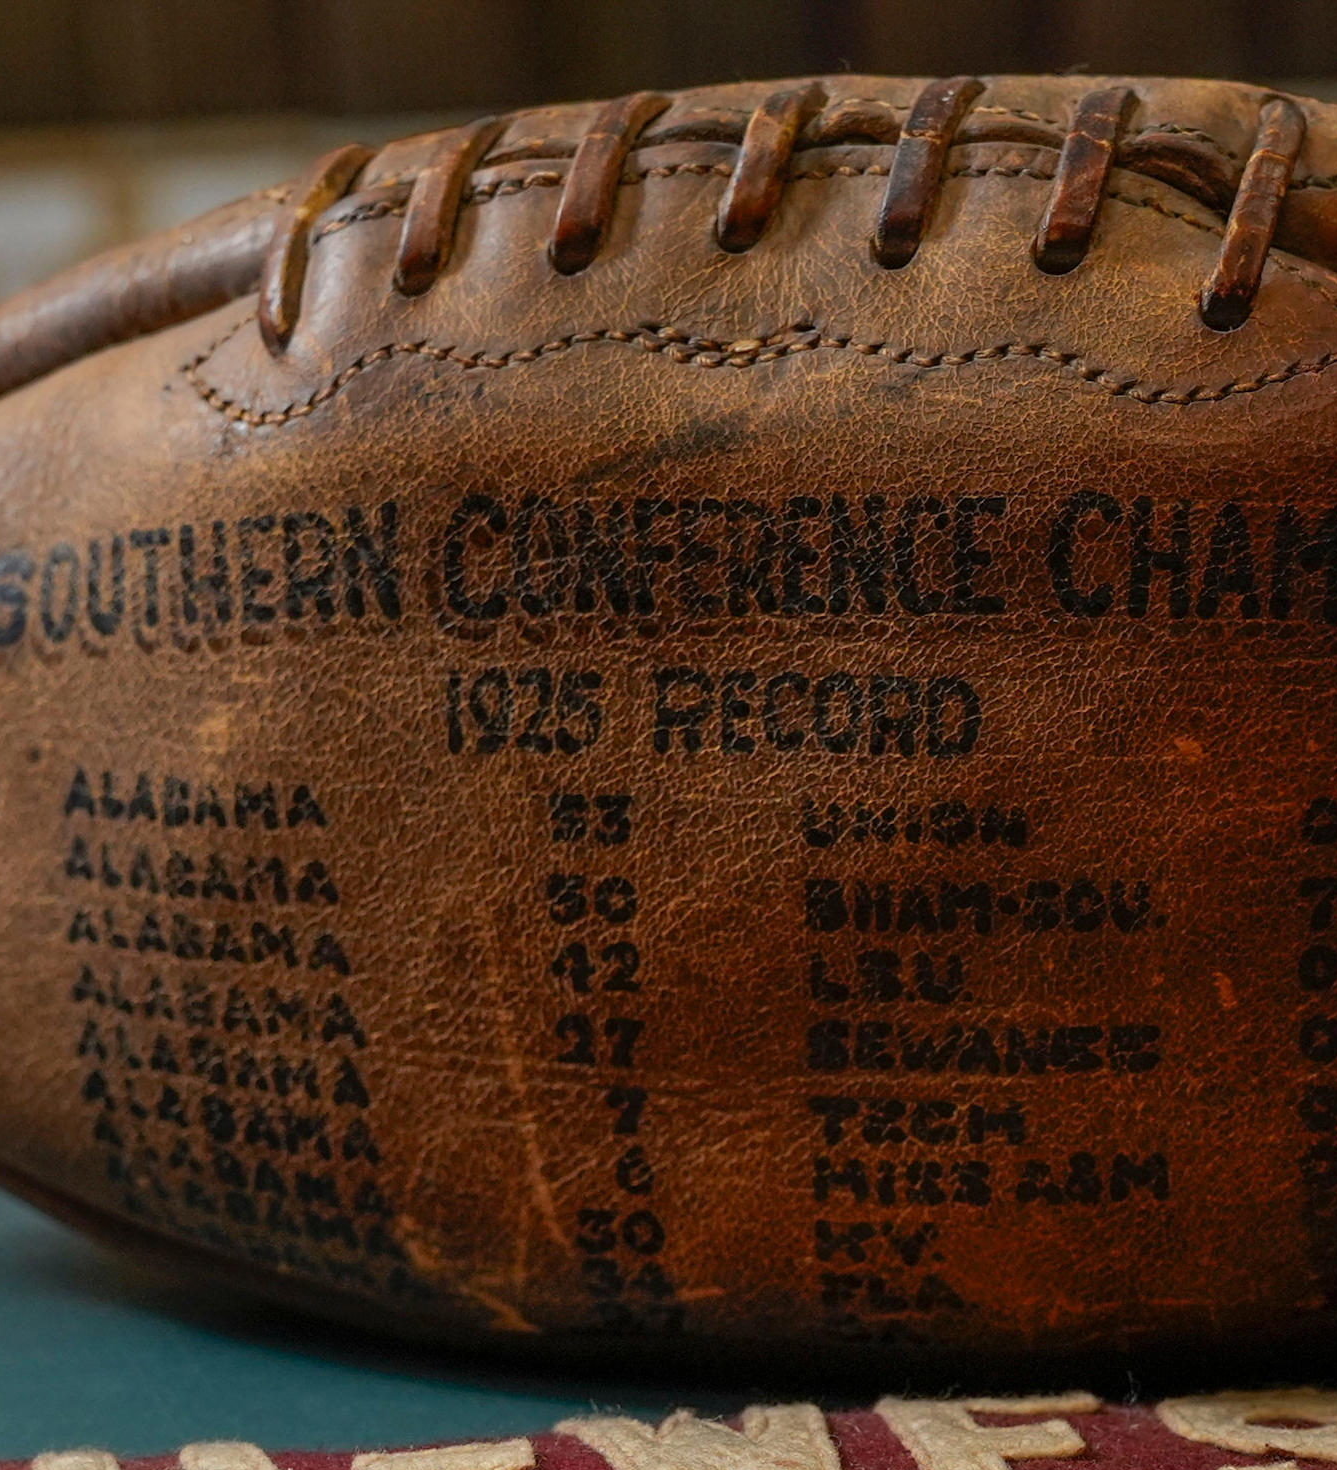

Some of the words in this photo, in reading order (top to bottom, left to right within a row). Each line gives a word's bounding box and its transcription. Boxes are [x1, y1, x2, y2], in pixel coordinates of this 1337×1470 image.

[444, 494, 1005, 620] CONFERENCE
[448, 668, 602, 754] 1925
[654, 668, 982, 757] RECORD
[67, 770, 329, 828] ALABAMA
[65, 838, 340, 905] ALABAMA
[68, 908, 352, 977] ALABAMA
[556, 1013, 645, 1067] 27
[605, 1086, 649, 1134] 7
